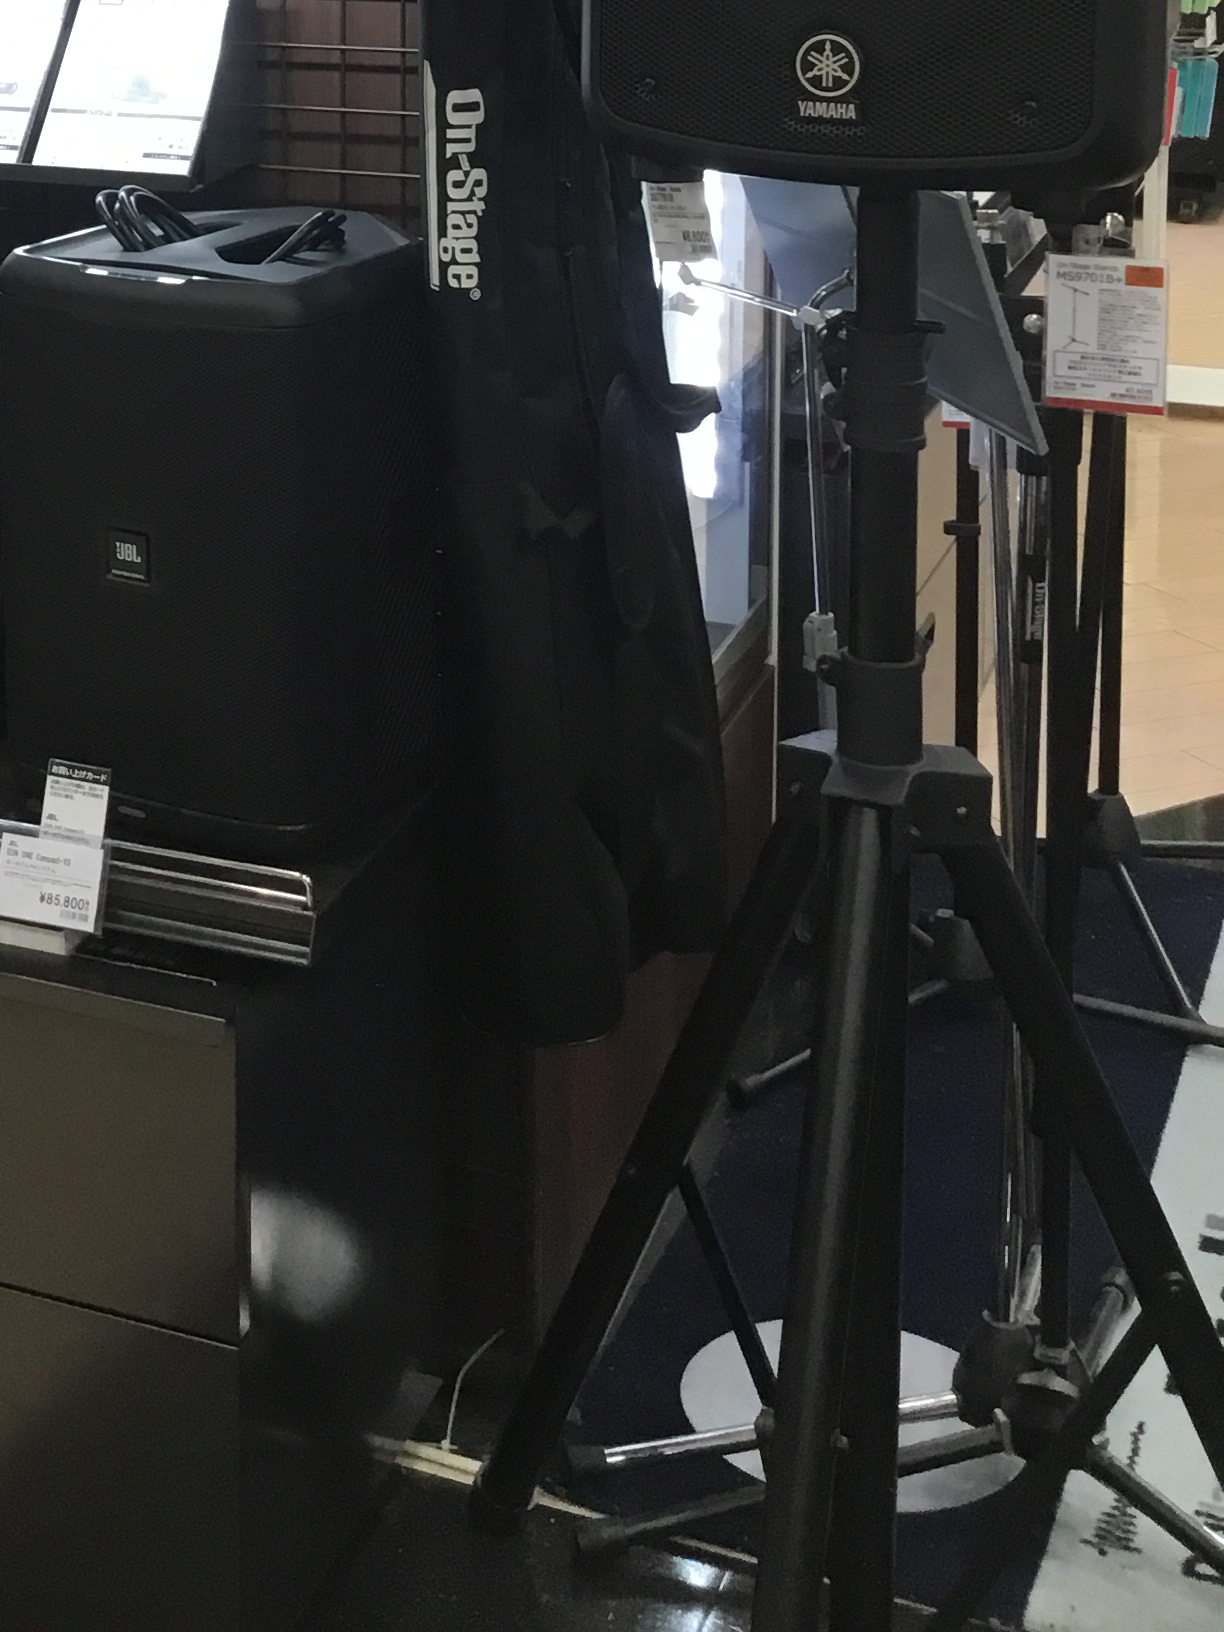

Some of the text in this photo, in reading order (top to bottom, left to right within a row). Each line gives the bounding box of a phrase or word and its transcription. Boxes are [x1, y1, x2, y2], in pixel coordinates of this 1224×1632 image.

[797, 100, 856, 120] YAMAHA
[439, 87, 488, 290] On-Stage
[115, 541, 142, 563] JBL
[39, 890, 85, 910] ¥85,800
